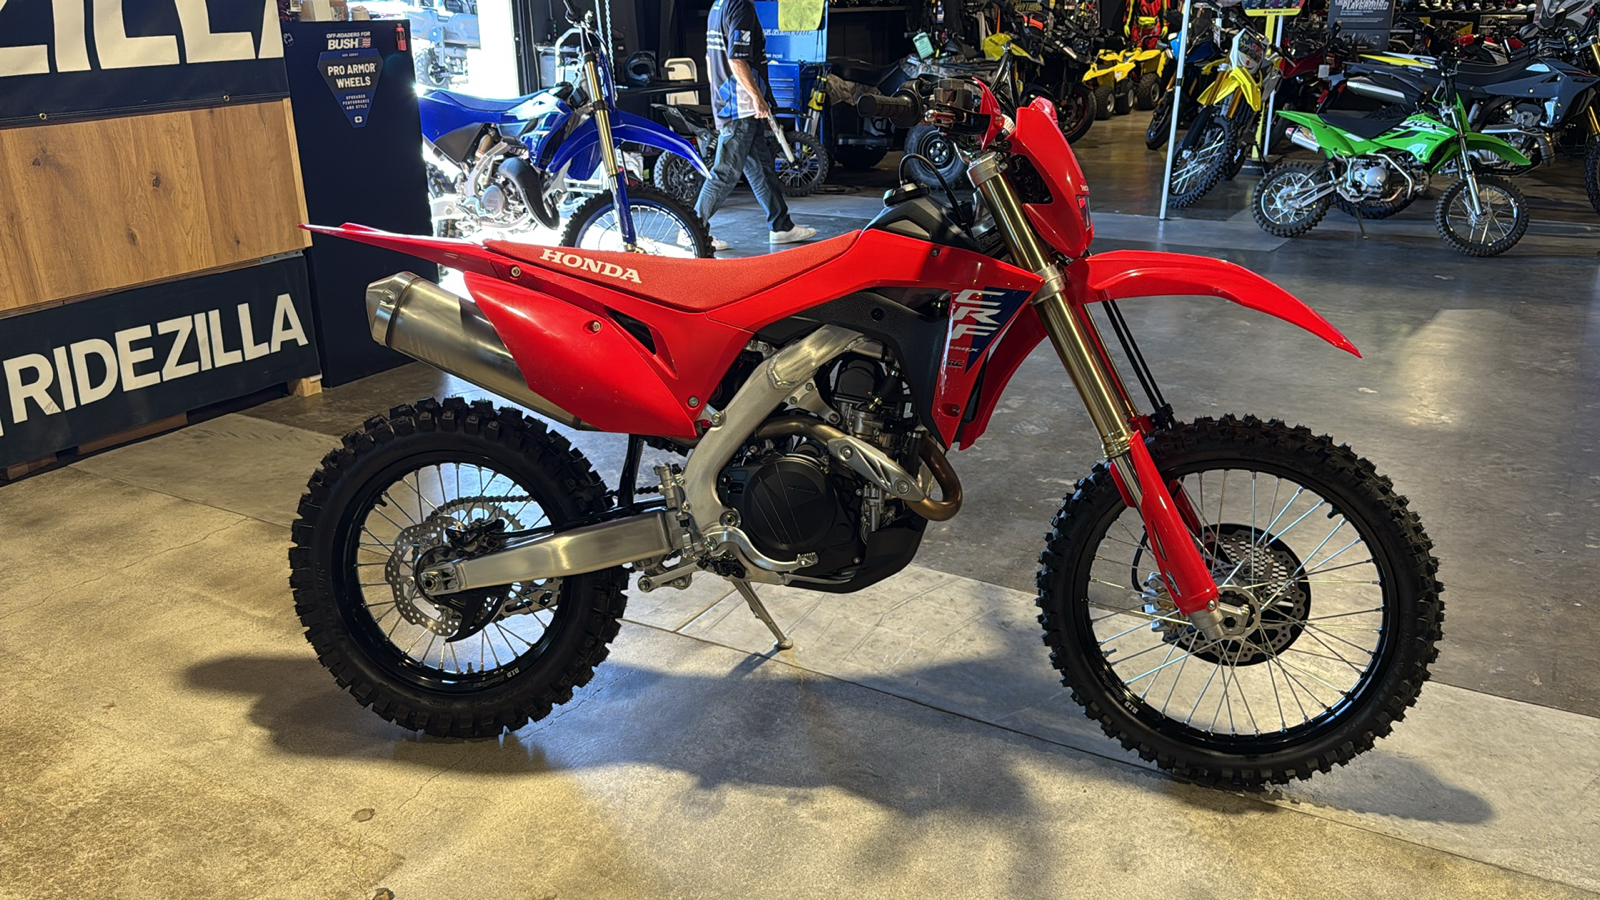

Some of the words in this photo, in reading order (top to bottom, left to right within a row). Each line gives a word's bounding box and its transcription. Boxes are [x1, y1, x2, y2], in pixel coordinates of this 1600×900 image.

[328, 38, 359, 50] BUSH
[327, 66, 346, 76] PRO
[347, 63, 376, 75] ARMOR
[336, 76, 371, 89] WHEELS
[539, 249, 642, 283] HONDA
[3, 293, 309, 424] RIDEZILLA
